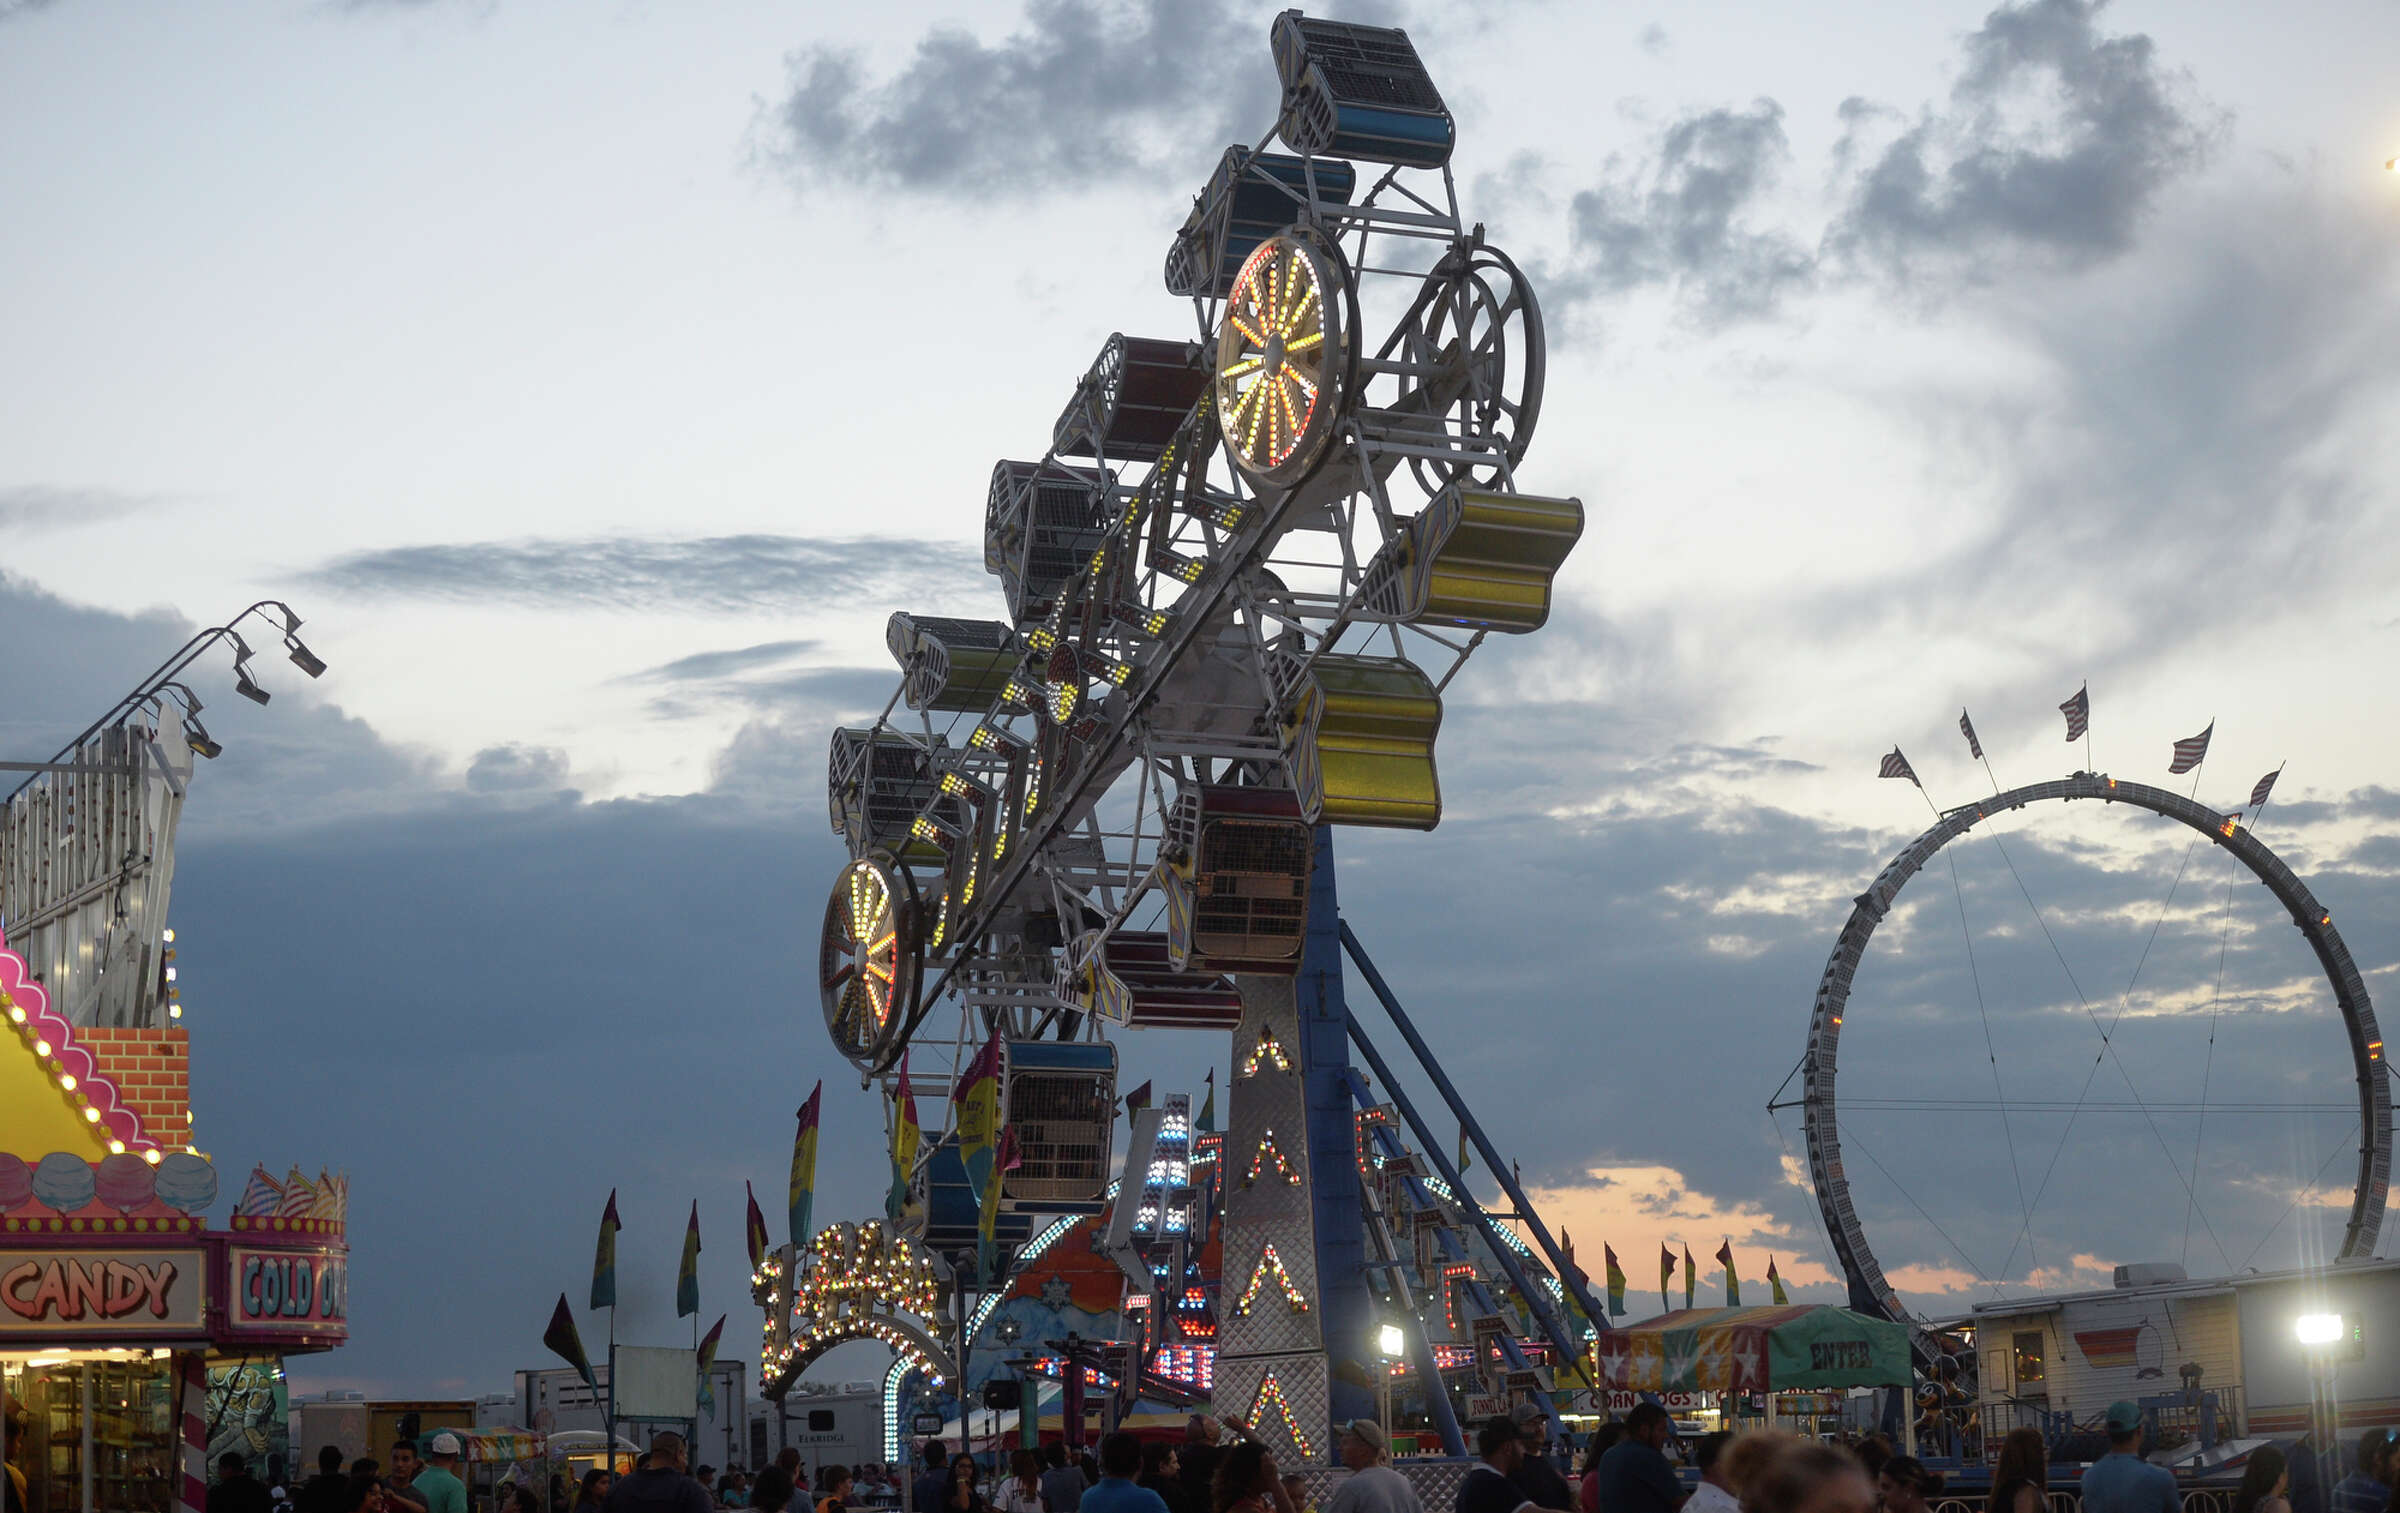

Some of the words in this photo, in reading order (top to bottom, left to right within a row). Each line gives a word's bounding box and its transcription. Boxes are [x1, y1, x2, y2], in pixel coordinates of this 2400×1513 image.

[1, 1257, 178, 1320] CANDY
[242, 1255, 313, 1318] COLD
[1810, 1340, 1871, 1370] ENTER
[1653, 1391, 1691, 1406] OGS
